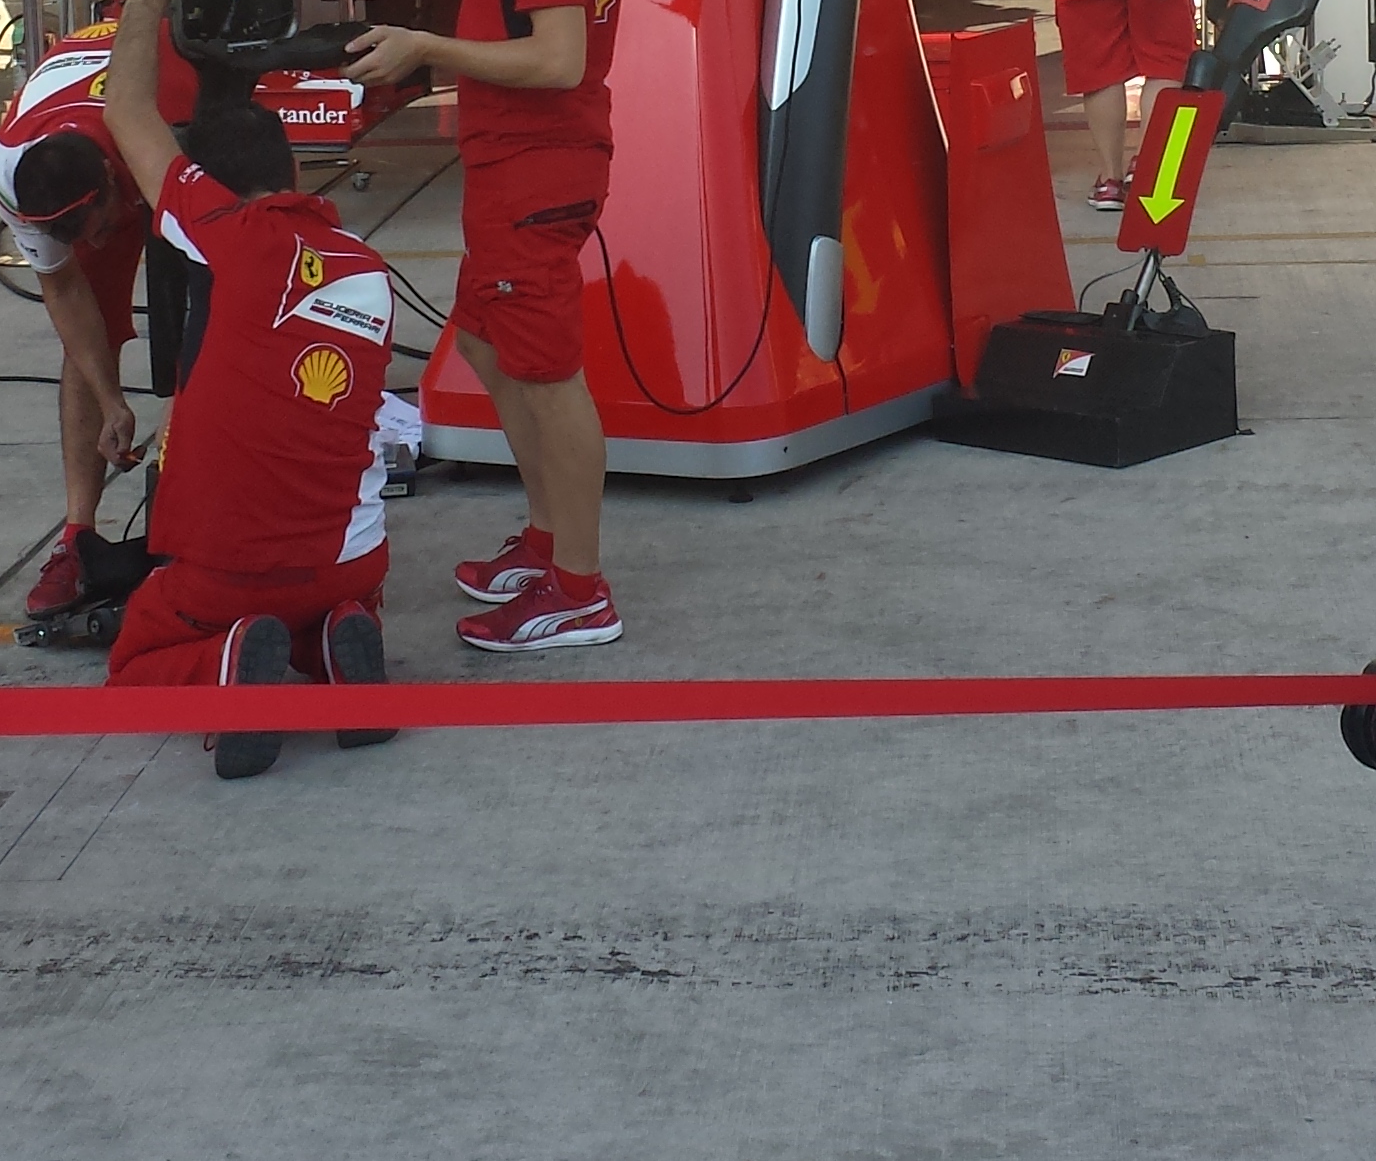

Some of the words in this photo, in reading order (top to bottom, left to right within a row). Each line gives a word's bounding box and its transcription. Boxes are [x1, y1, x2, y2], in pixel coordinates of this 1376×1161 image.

[278, 102, 349, 125] tander
[313, 297, 372, 321] SCUDERIA
[333, 312, 382, 334] FERRARI
